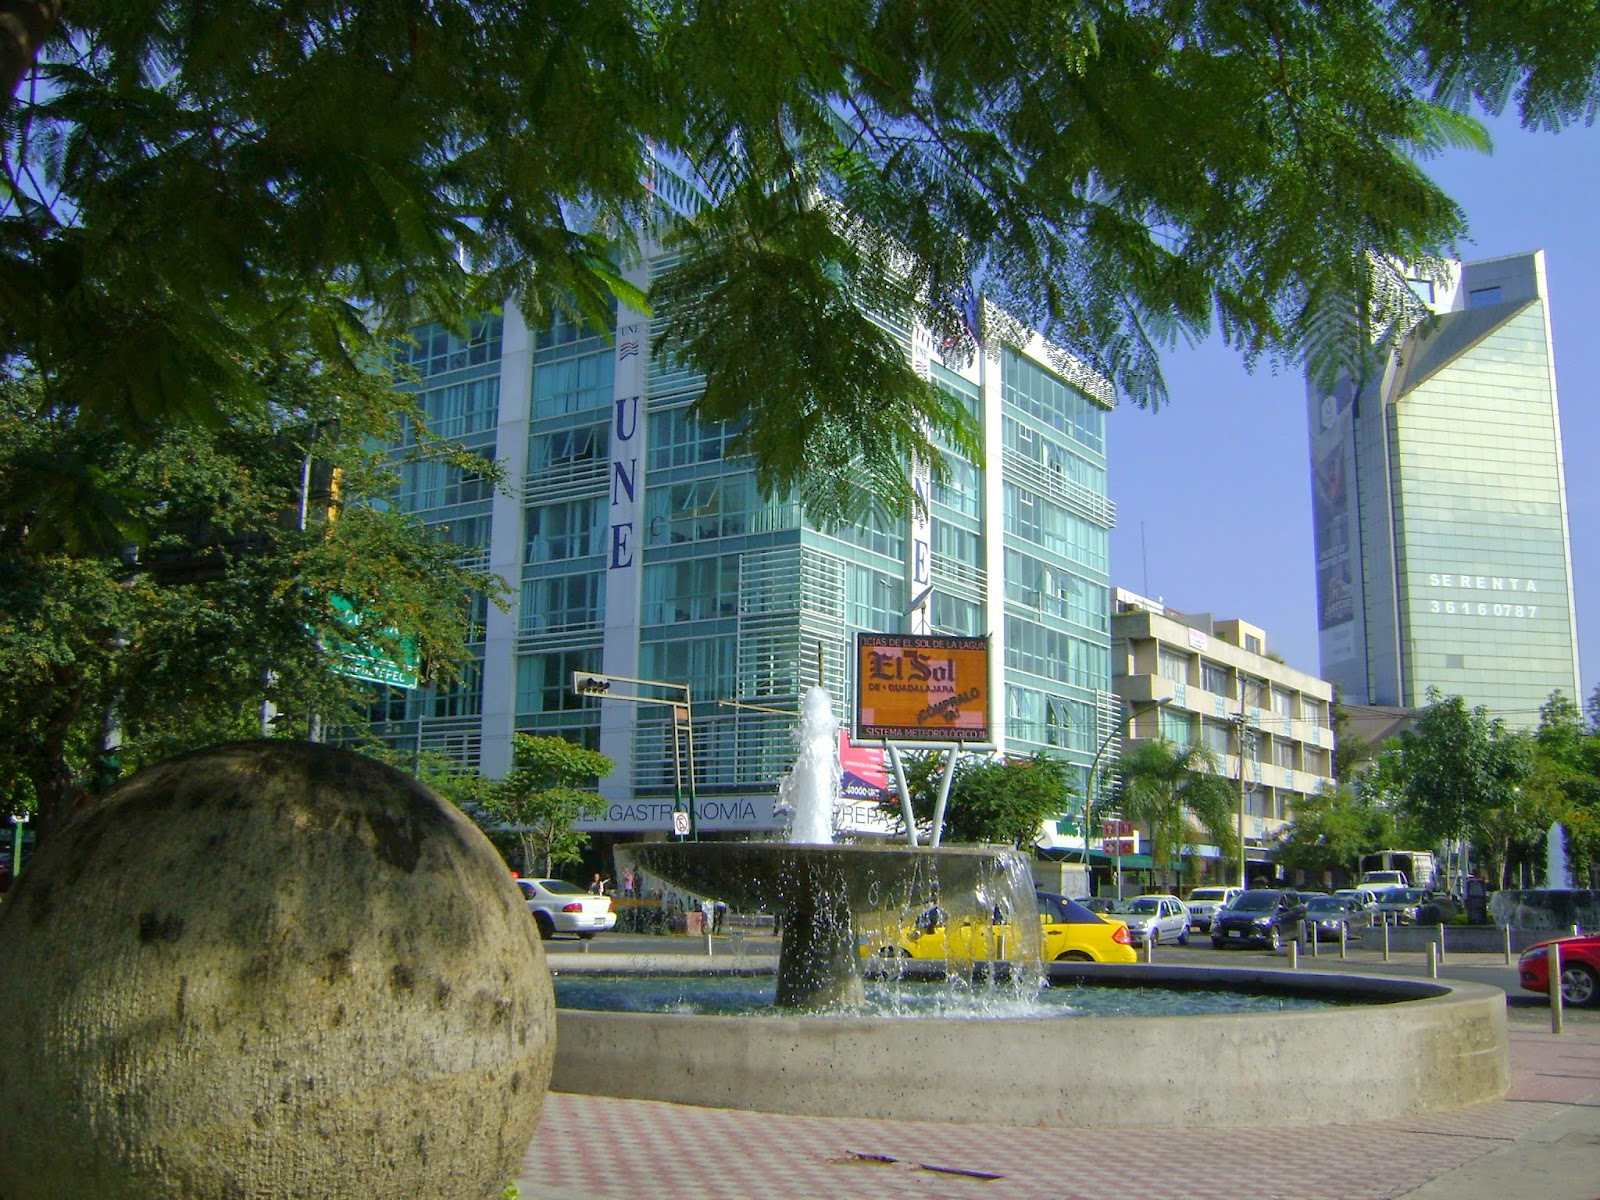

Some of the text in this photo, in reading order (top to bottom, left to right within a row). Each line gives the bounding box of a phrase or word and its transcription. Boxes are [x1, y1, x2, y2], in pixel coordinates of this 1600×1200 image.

[621, 325, 640, 337] UNE
[609, 396, 639, 570] UNE
[1430, 573, 1537, 592] SE RENTA
[889, 638, 900, 647] DE
[903, 639, 912, 647] EL
[915, 639, 932, 648] SOL
[933, 640, 944, 648] DE
[946, 640, 957, 649] LA
[867, 650, 956, 683] El Sol
[868, 683, 955, 694] DE GUADALAJARA
[866, 728, 903, 736] SISTEMA
[905, 728, 978, 739] METEOROLÓGICO
